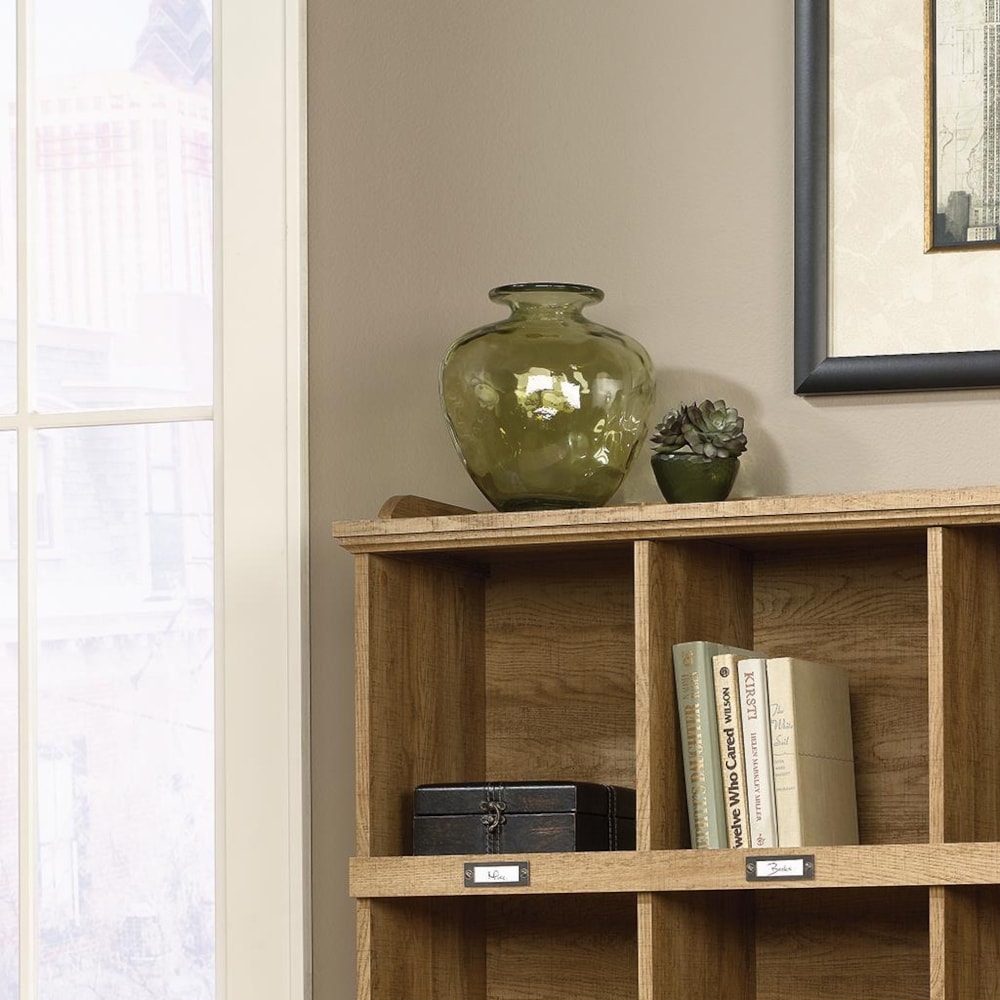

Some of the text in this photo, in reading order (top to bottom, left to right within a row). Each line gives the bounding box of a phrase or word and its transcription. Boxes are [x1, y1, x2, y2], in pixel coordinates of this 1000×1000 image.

[723, 687, 744, 849] welve Who Cared WILSON
[744, 671, 763, 822] KIRSTI HELEN MARKLEY MILLER
